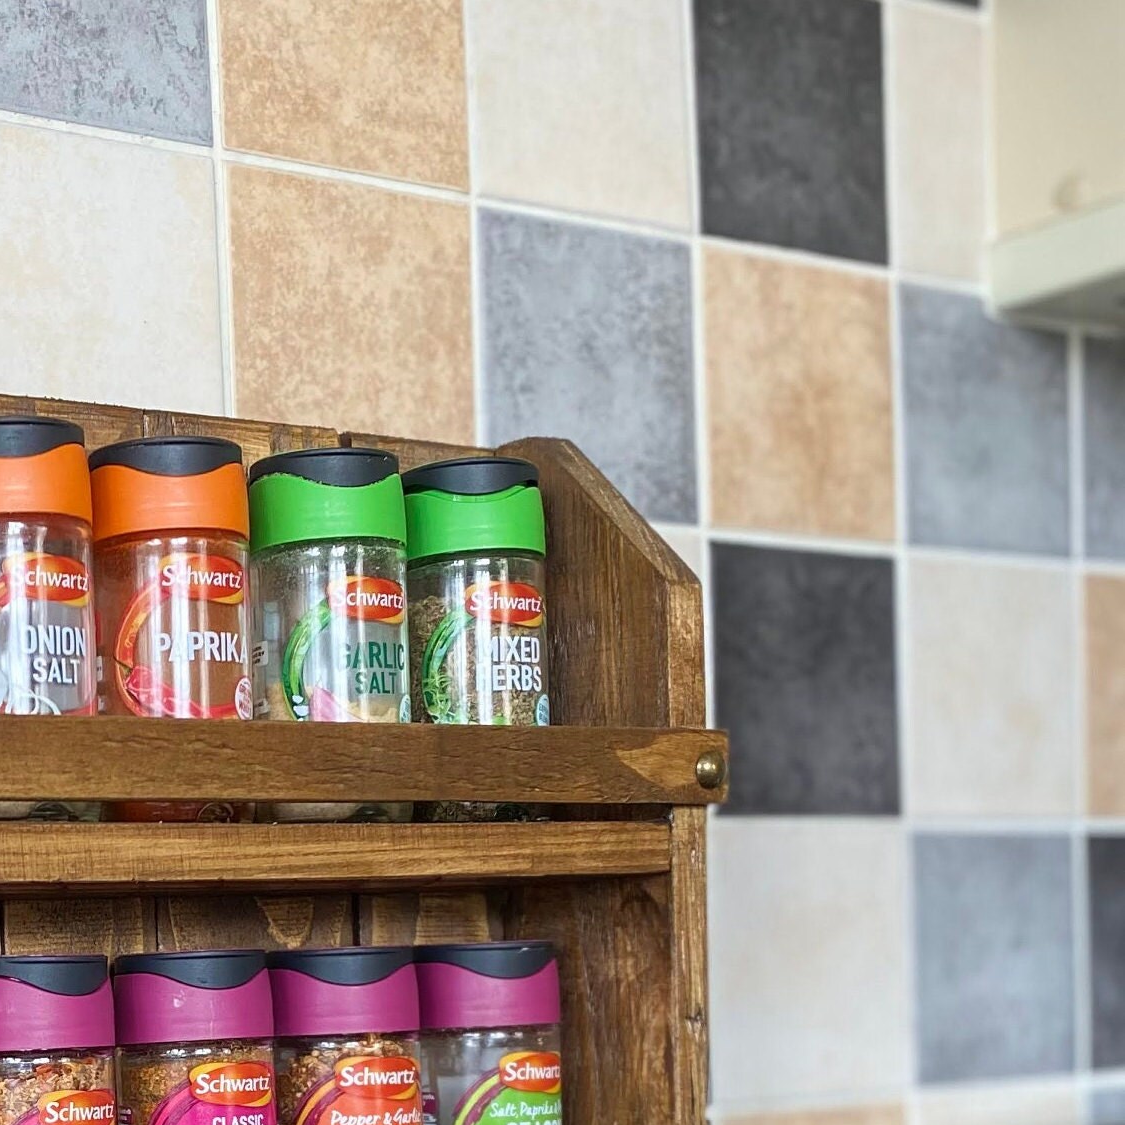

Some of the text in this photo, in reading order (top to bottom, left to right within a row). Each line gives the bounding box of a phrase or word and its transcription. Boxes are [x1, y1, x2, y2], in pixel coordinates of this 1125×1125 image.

[10, 564, 89, 592] Schwartz
[162, 564, 243, 589] Schwartz
[332, 586, 404, 609] Schwartz
[470, 591, 542, 612] Schwartz
[21, 623, 87, 657] ONION
[155, 631, 249, 664] PAPRIKA
[33, 657, 81, 684] SALT
[355, 671, 397, 694] SALT
[195, 1073, 270, 1094] Schwartz
[340, 1066, 416, 1087] Schwartz
[44, 1101, 115, 1123] Schwartz
[383, 1112, 393, 1125] &
